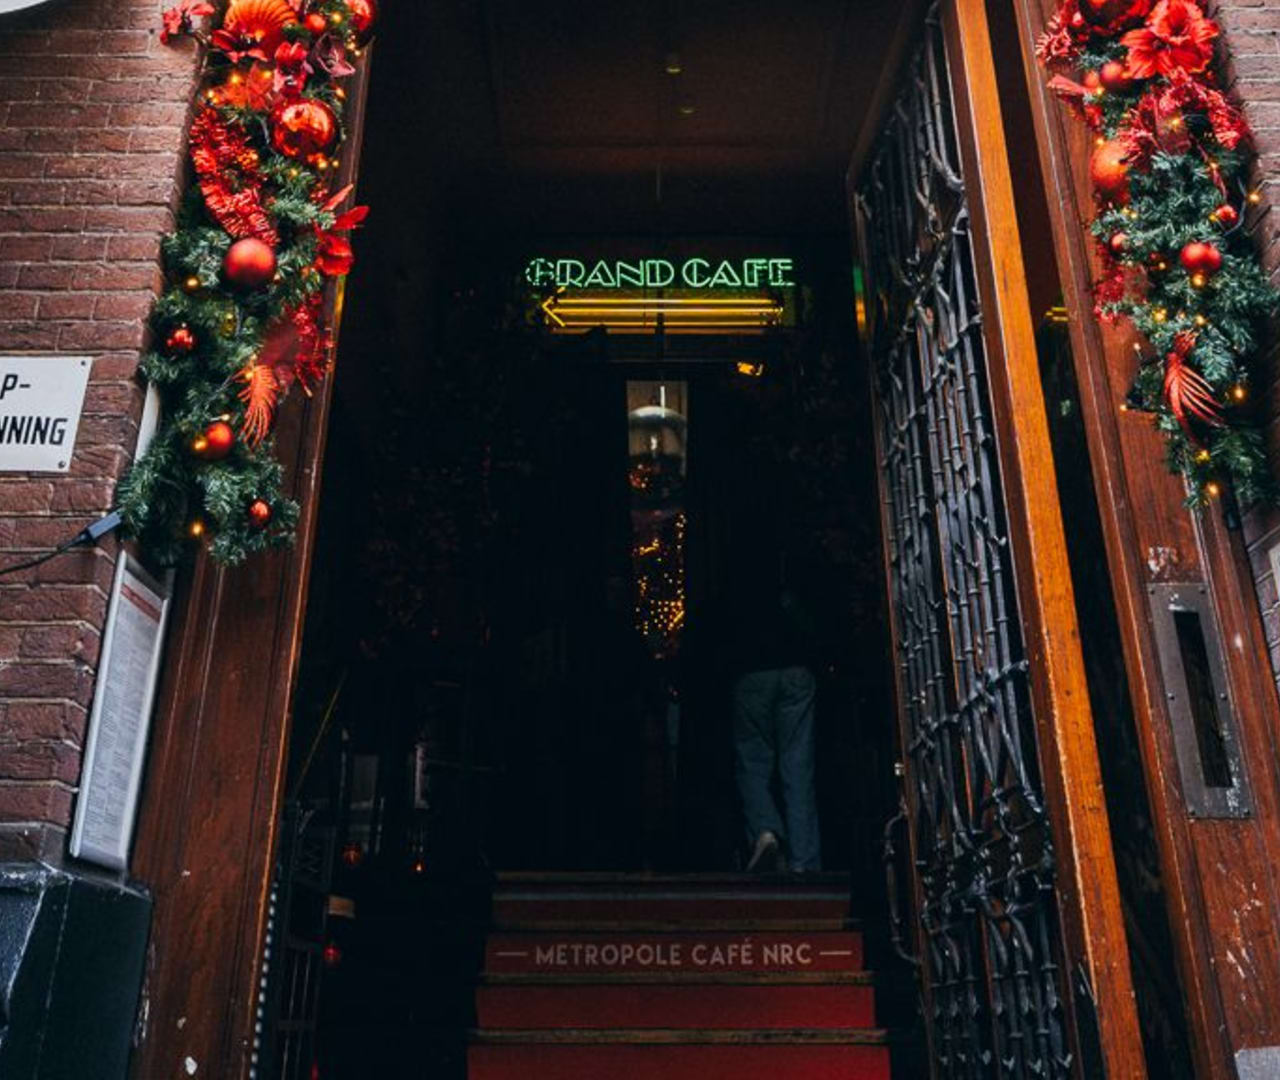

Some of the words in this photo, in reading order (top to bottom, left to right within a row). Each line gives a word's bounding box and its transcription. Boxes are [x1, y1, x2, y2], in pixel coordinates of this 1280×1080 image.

[524, 257, 675, 288] GRAND
[681, 257, 797, 288] CAFE
[534, 943, 682, 967] METROPOLE
[690, 937, 754, 967] CAFÉ
[762, 943, 813, 966] NRC
